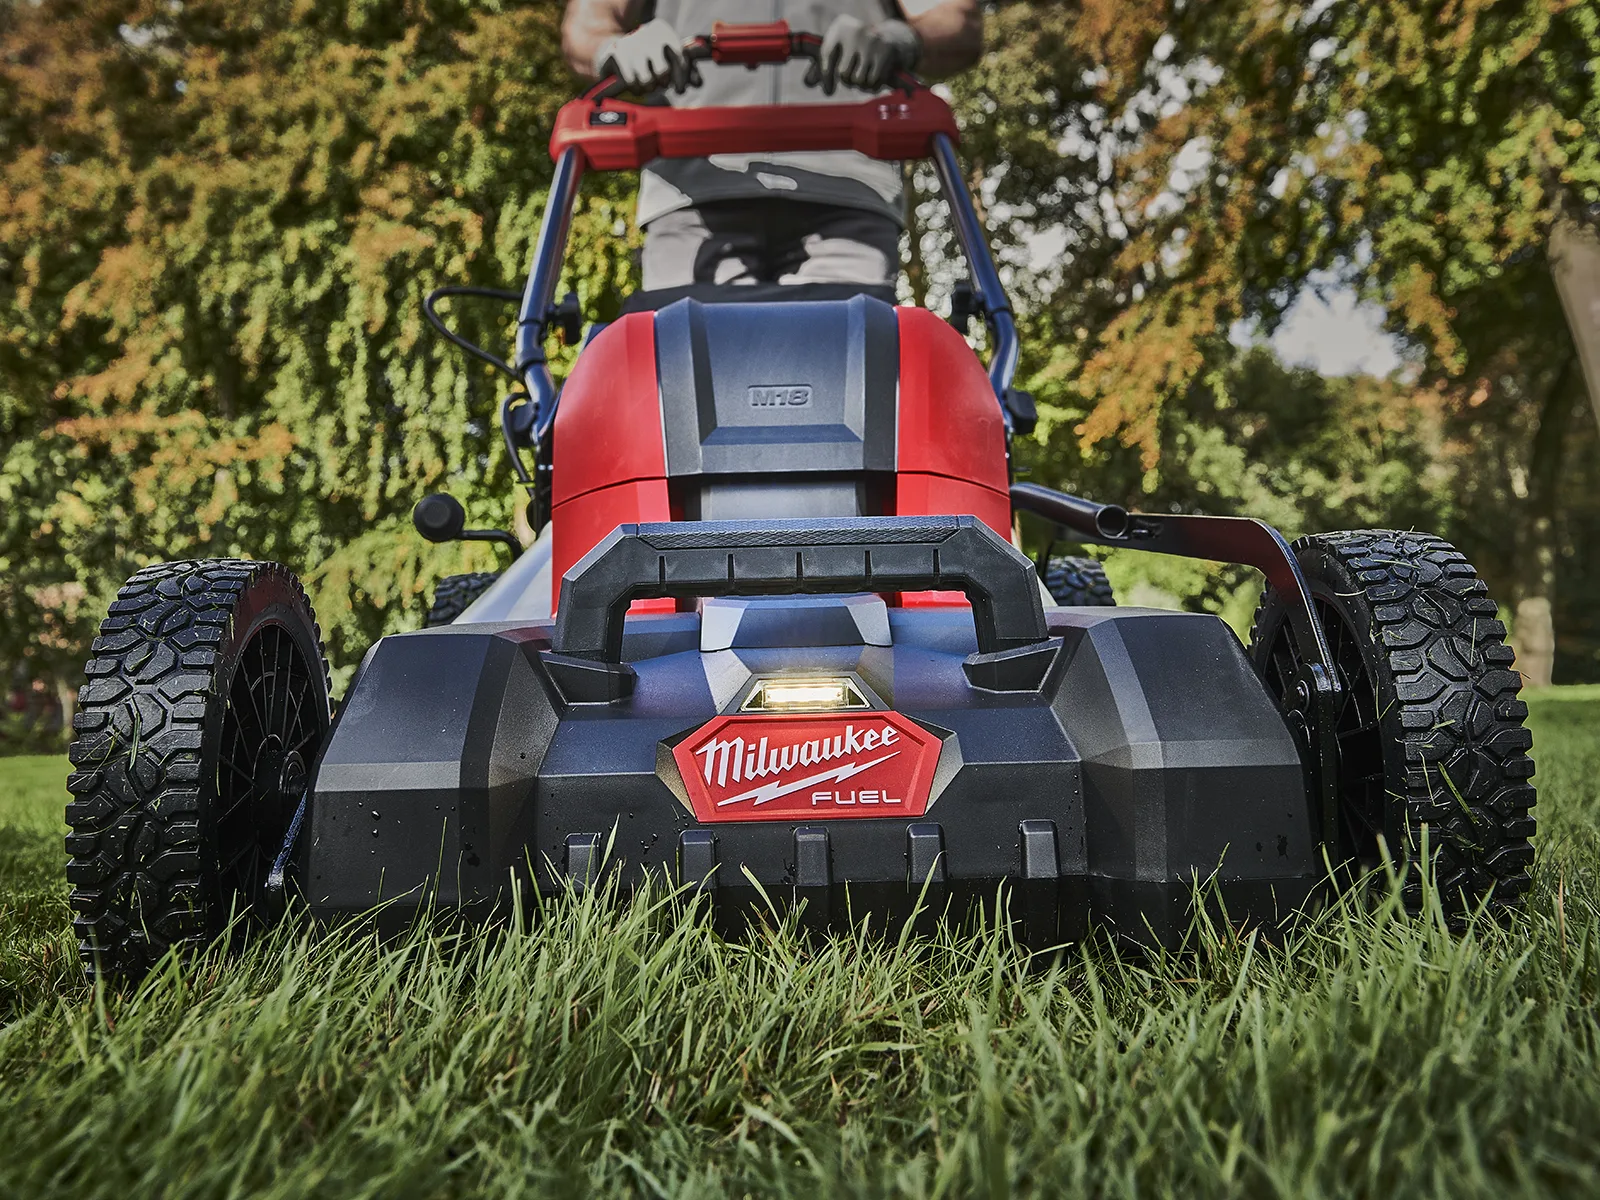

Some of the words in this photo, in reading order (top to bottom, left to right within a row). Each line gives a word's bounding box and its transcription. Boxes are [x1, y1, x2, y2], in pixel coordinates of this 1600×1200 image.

[751, 389, 809, 406] M18
[696, 725, 900, 788] Milwaukee
[811, 790, 901, 806] FUEL
